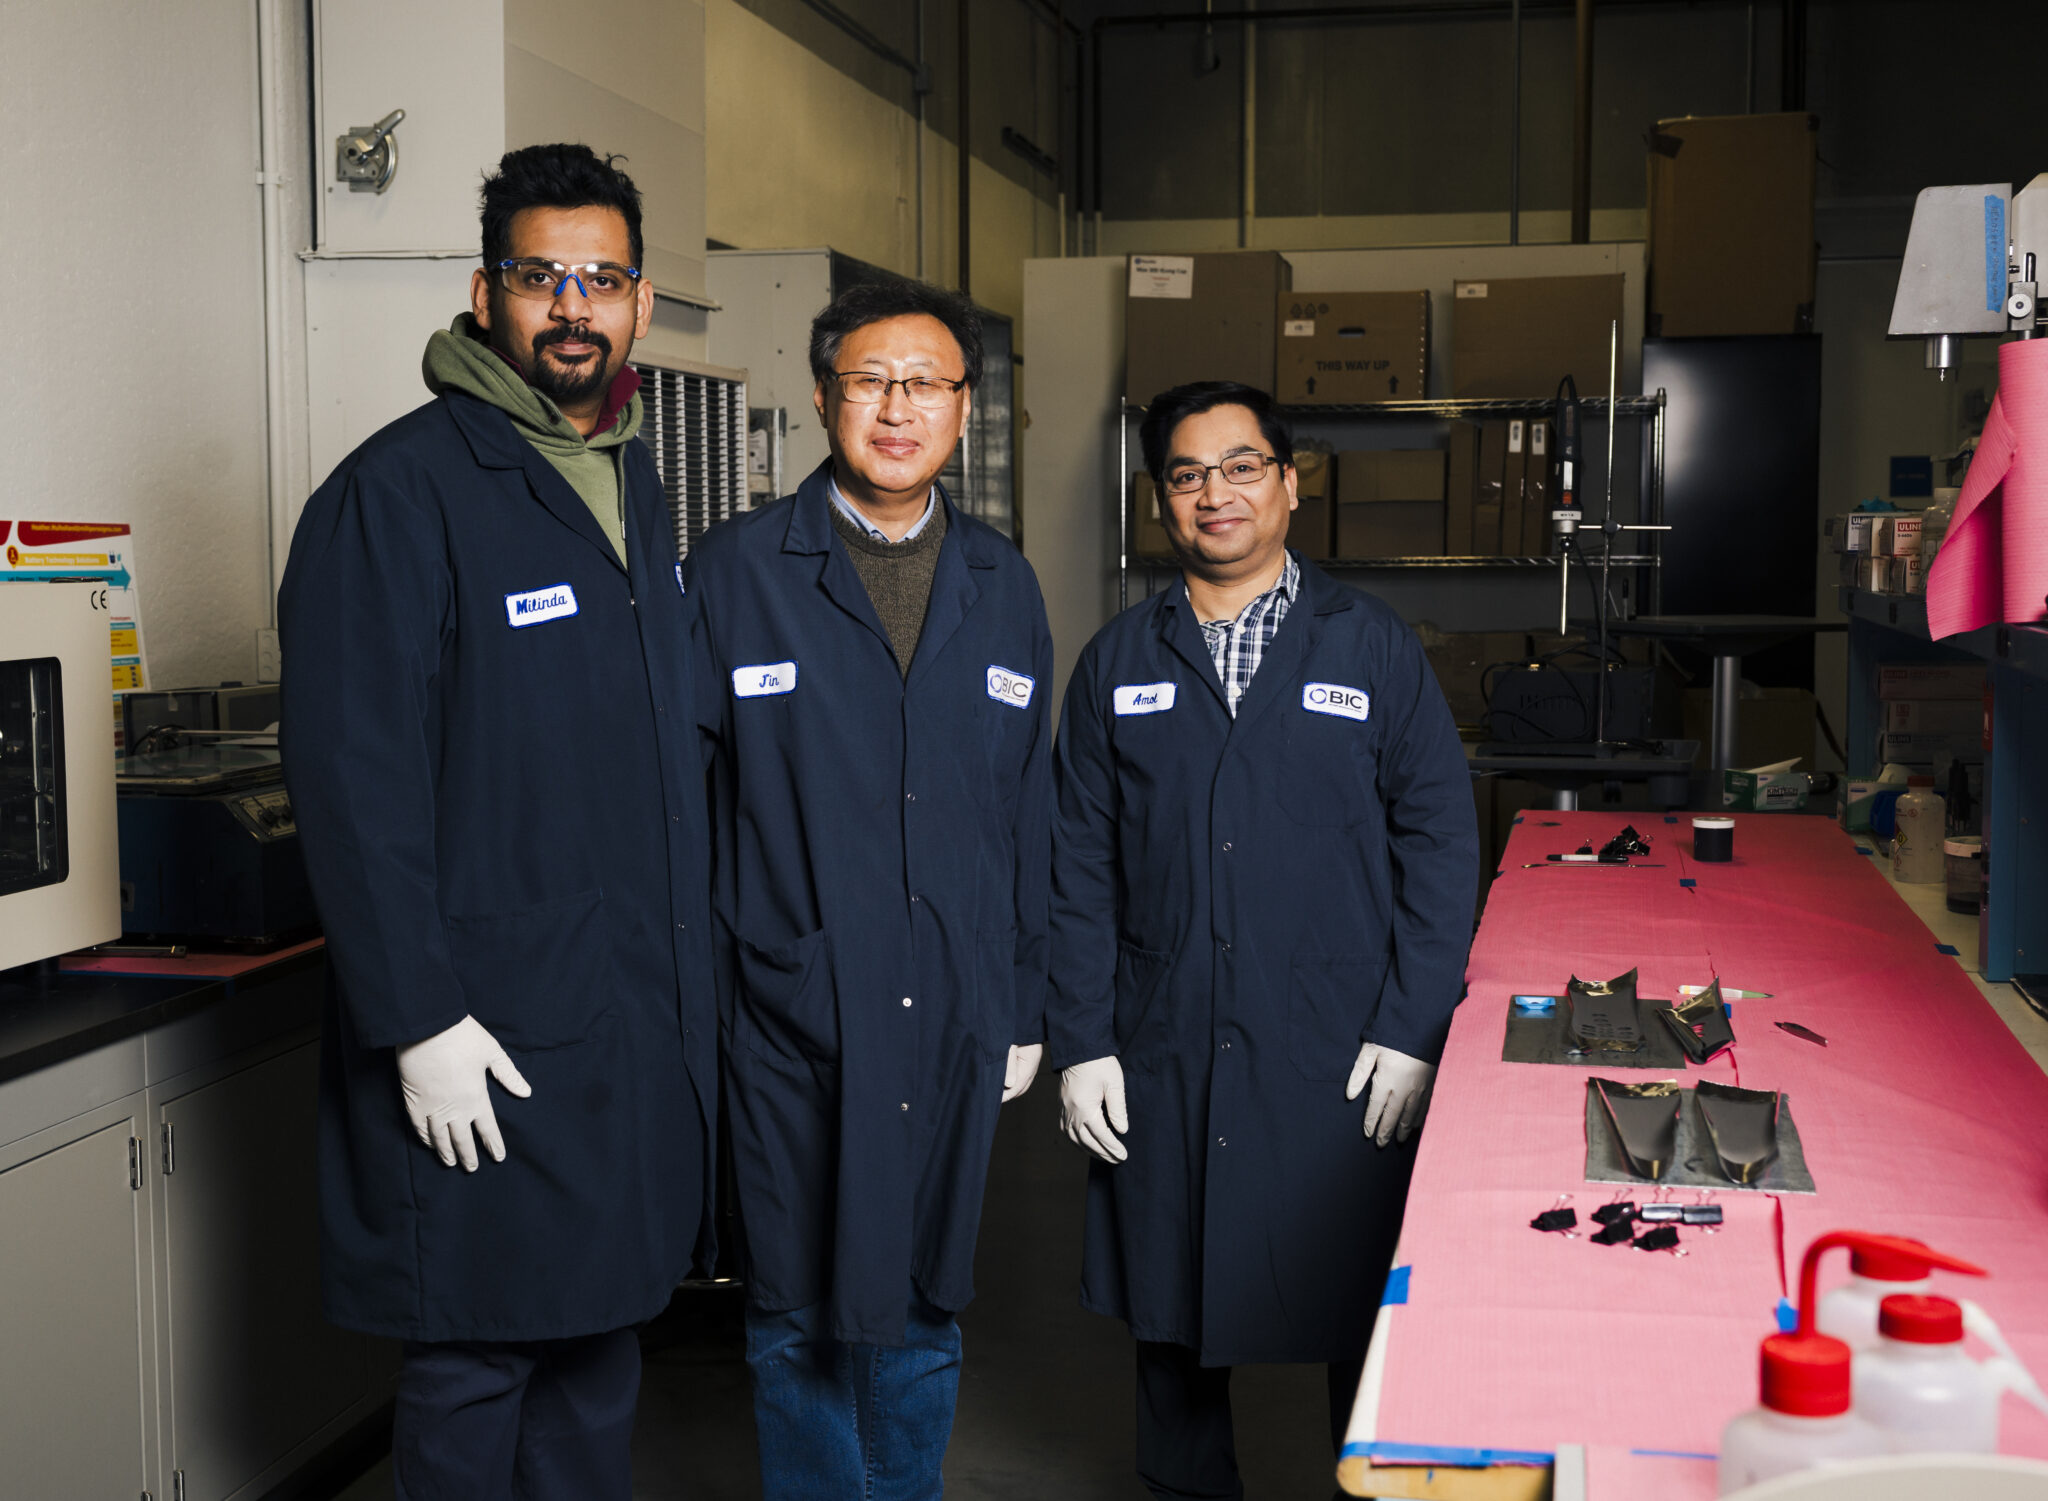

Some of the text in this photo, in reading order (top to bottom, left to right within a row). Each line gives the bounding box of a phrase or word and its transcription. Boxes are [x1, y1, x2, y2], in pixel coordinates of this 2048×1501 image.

[1316, 360, 1390, 371] THIS WAY UP
[759, 674, 779, 688] Jin
[1767, 786, 1798, 796] KIMTECH
